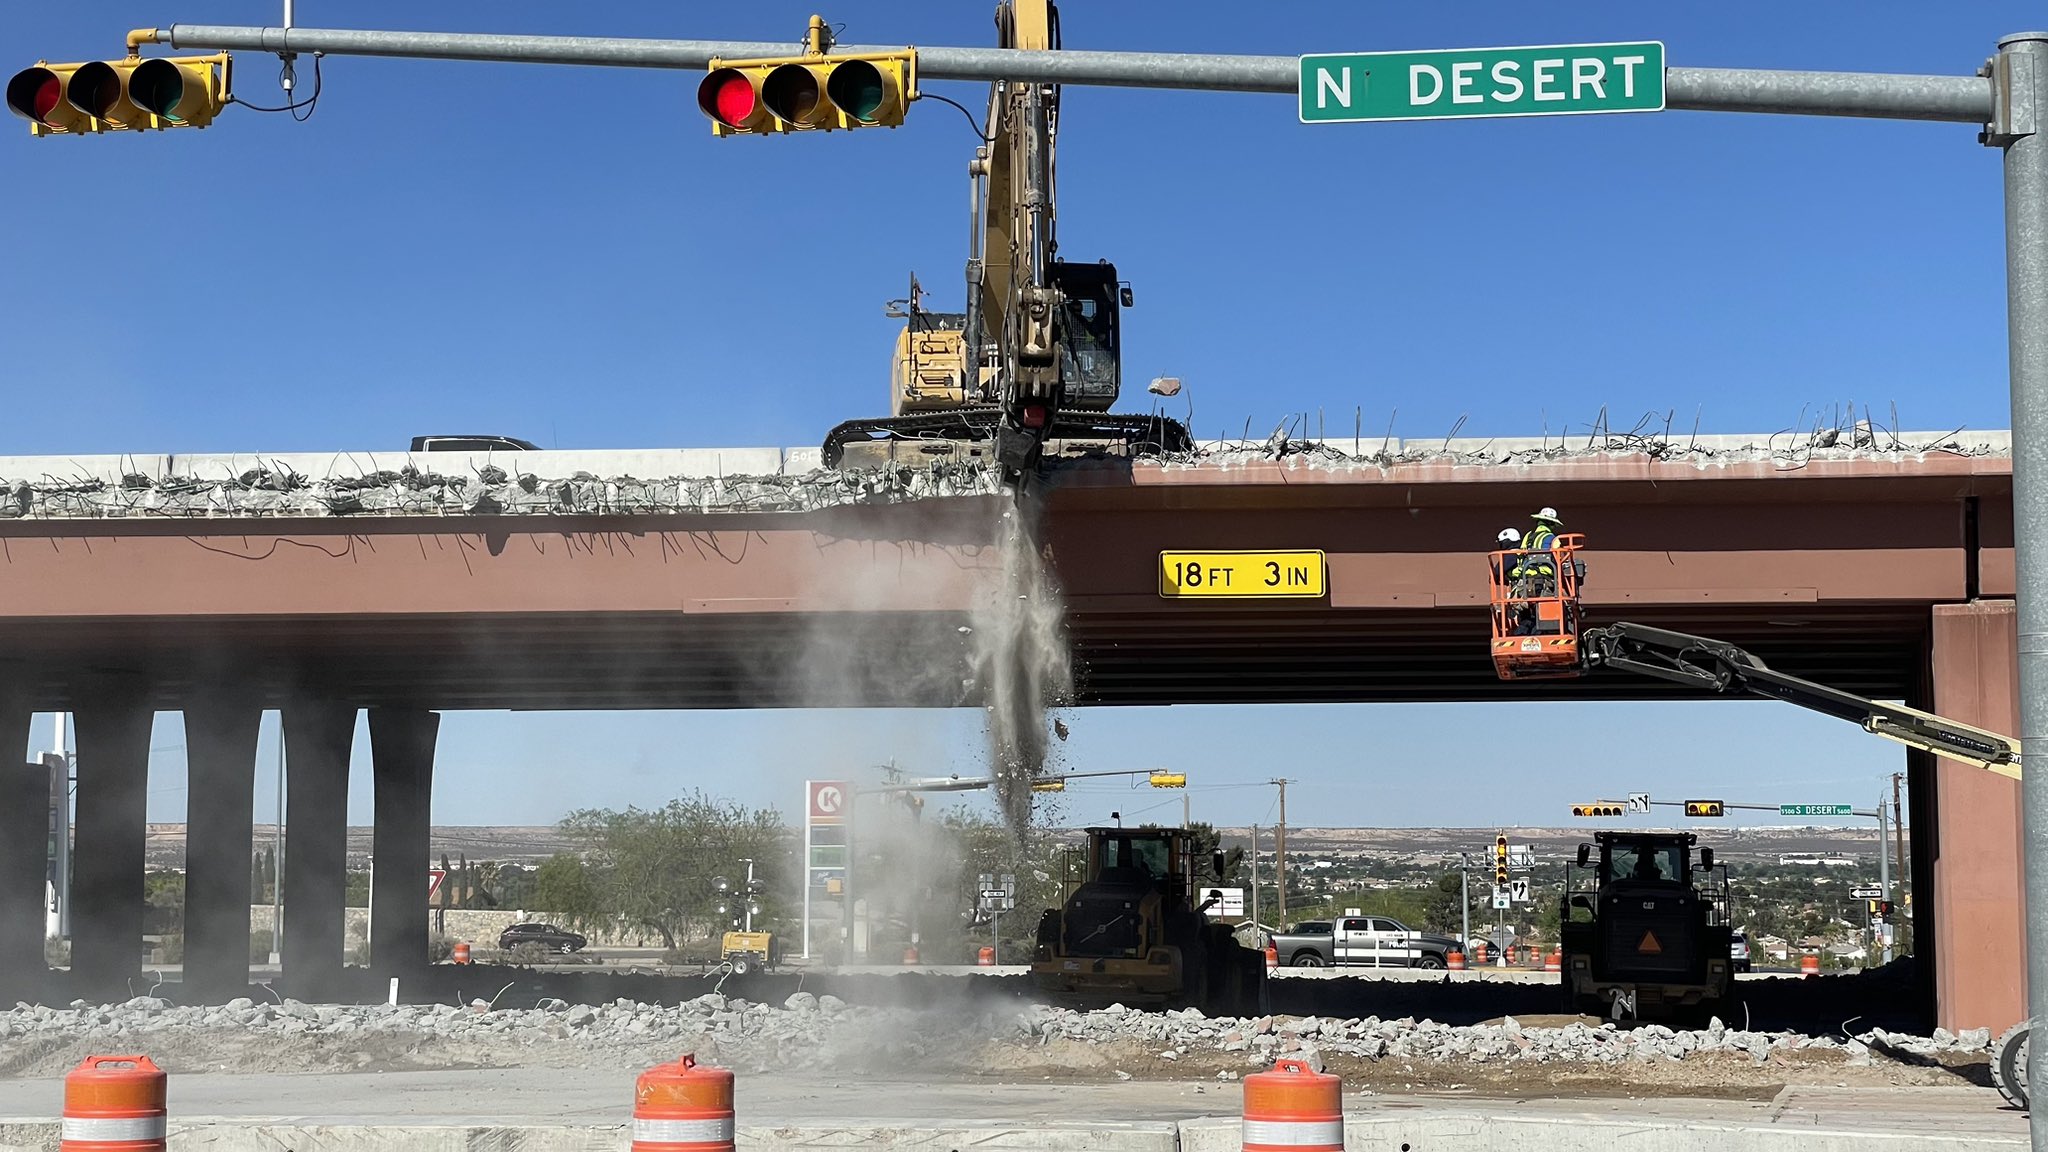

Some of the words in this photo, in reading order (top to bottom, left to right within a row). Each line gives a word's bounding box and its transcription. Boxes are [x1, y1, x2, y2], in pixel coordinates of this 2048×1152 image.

[1317, 67, 1351, 109] N
[1409, 56, 1645, 106] DESERT
[1175, 562, 1202, 587] 18
[1209, 568, 1234, 586] FT
[1264, 561, 1280, 586] 3
[1288, 567, 1308, 586] IN
[823, 792, 840, 811] K
[1796, 806, 1801, 814] S
[1806, 806, 1836, 814] DESERT
